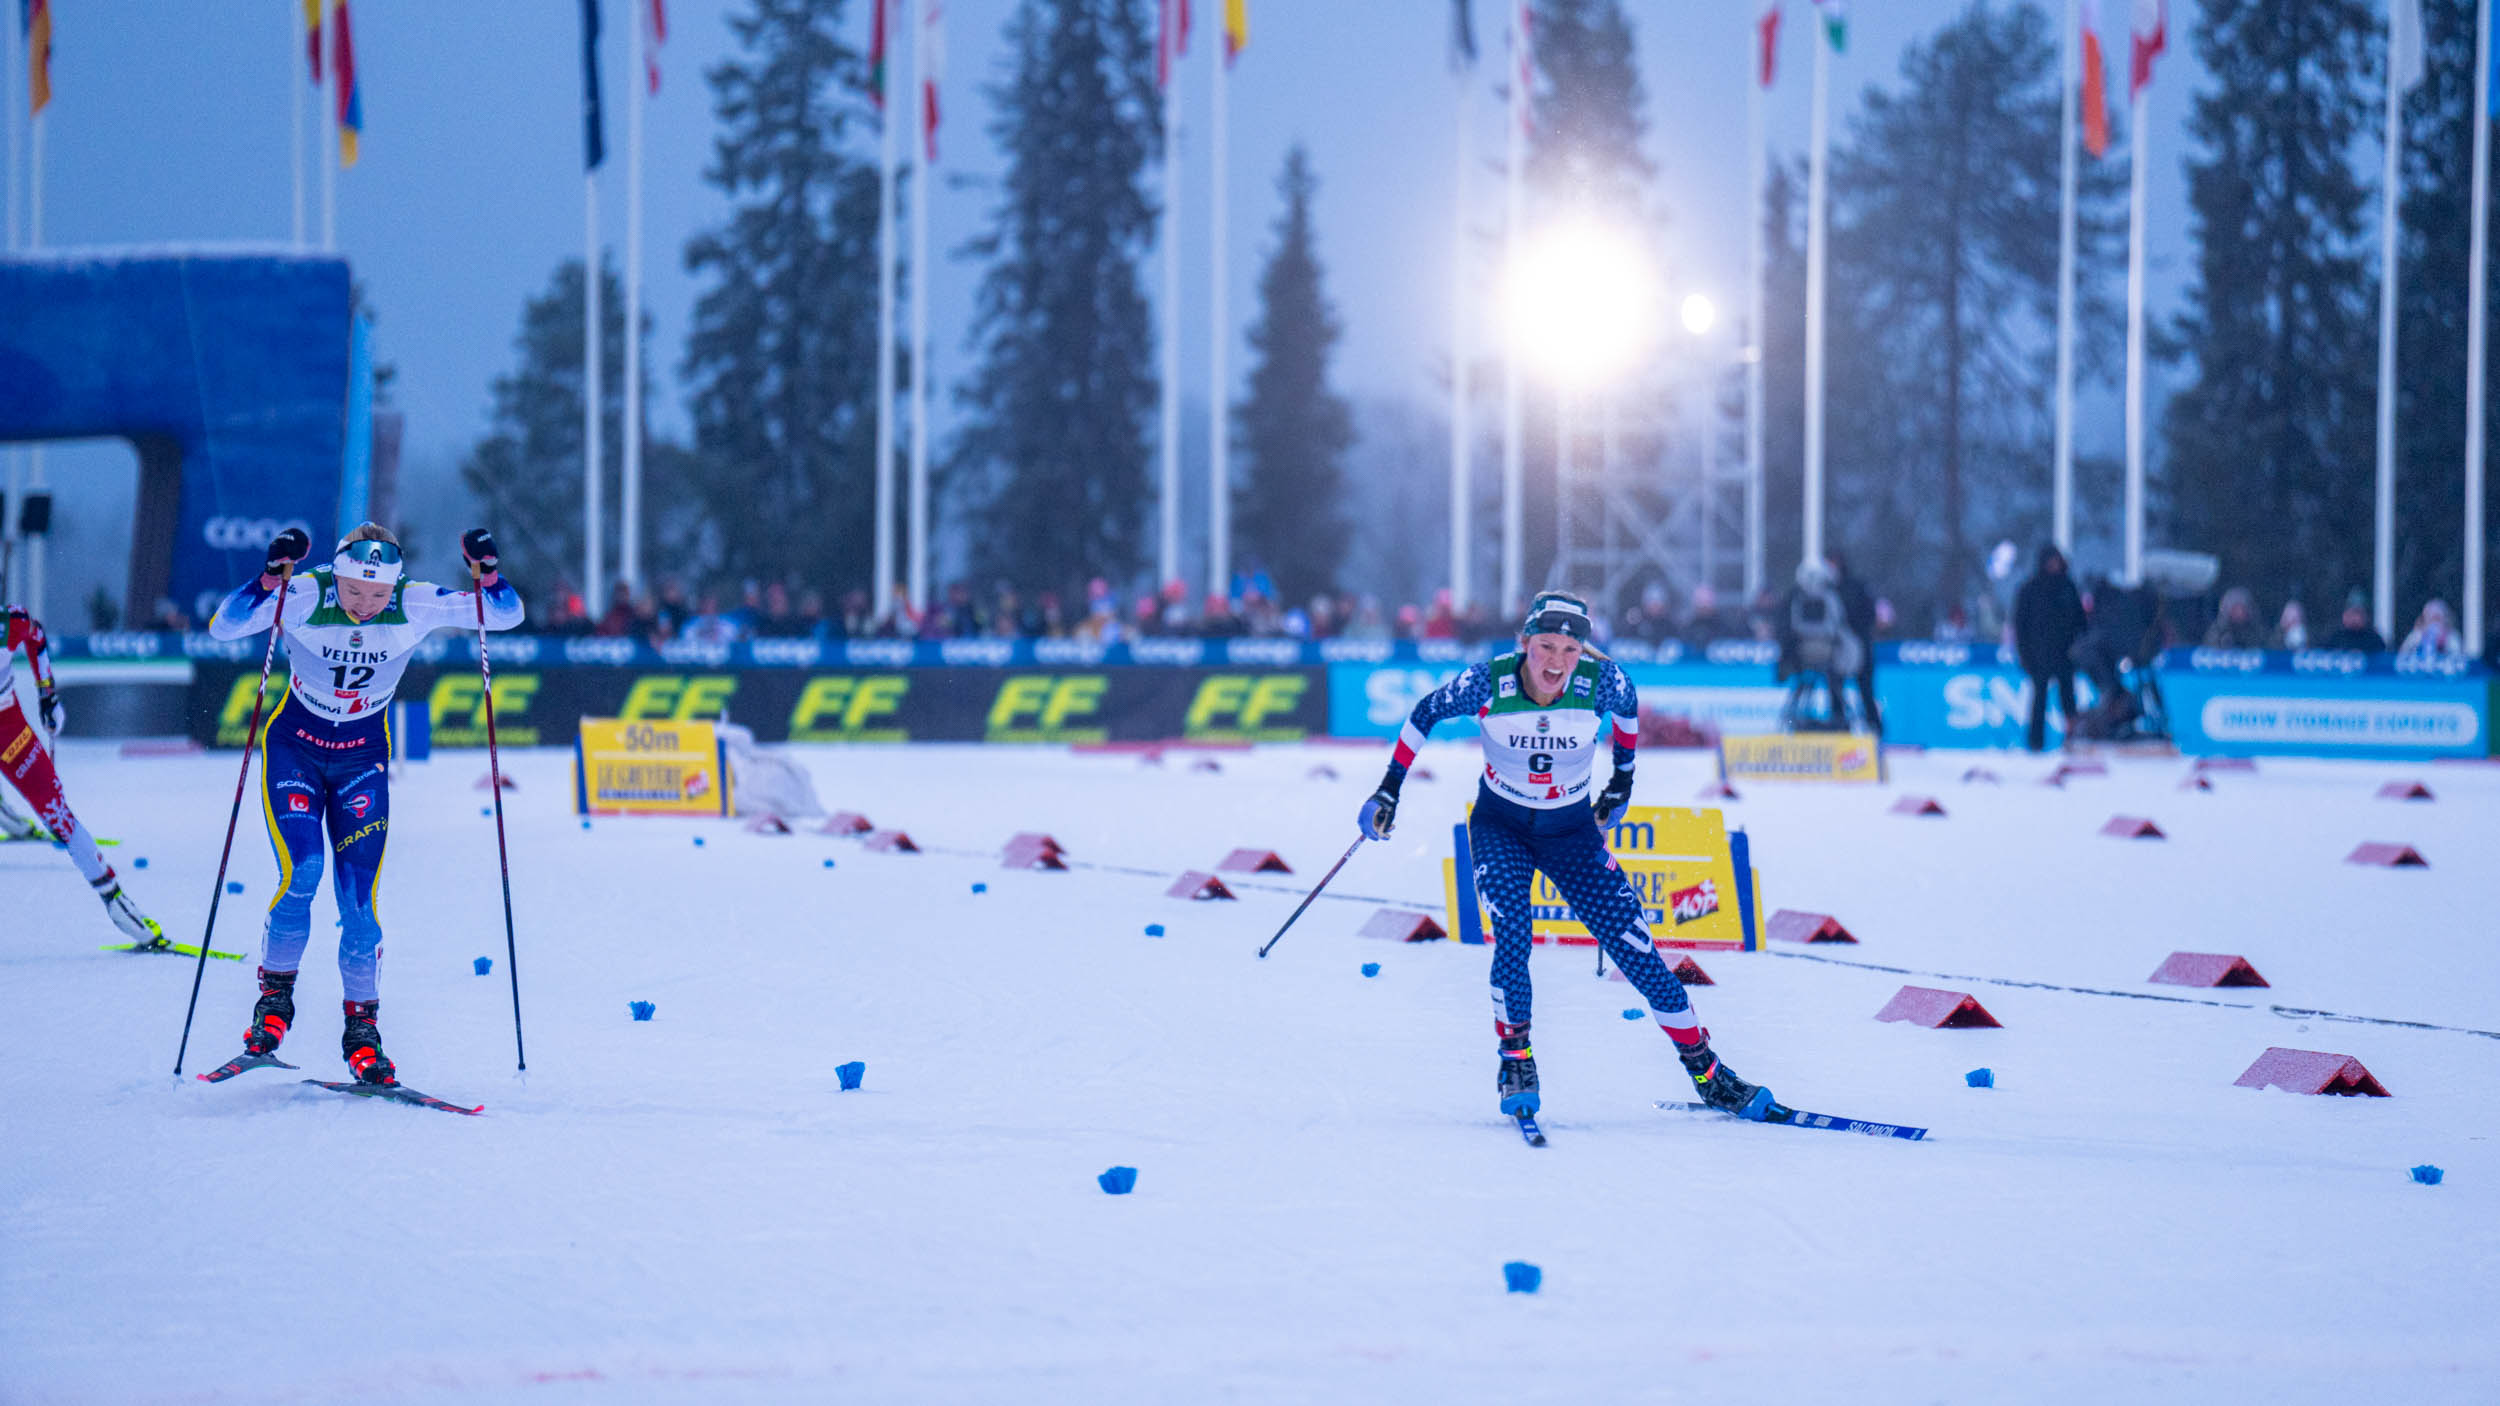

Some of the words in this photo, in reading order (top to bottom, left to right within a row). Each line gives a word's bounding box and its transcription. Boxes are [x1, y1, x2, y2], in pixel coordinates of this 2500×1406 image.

[322, 645, 388, 664] VELTINS
[329, 665, 375, 690] 12
[430, 672, 537, 726] FF
[620, 675, 735, 721] FF
[795, 676, 908, 727] FF
[990, 676, 1107, 726] FF
[1188, 676, 1305, 726] FF
[296, 728, 366, 749] BAUHAUS
[626, 725, 679, 751] 50m
[1508, 734, 1578, 750] VELTINS
[336, 821, 381, 852] CRAFT
[1674, 893, 1718, 920] AOP
[1848, 1120, 1898, 1137] SALOMON
